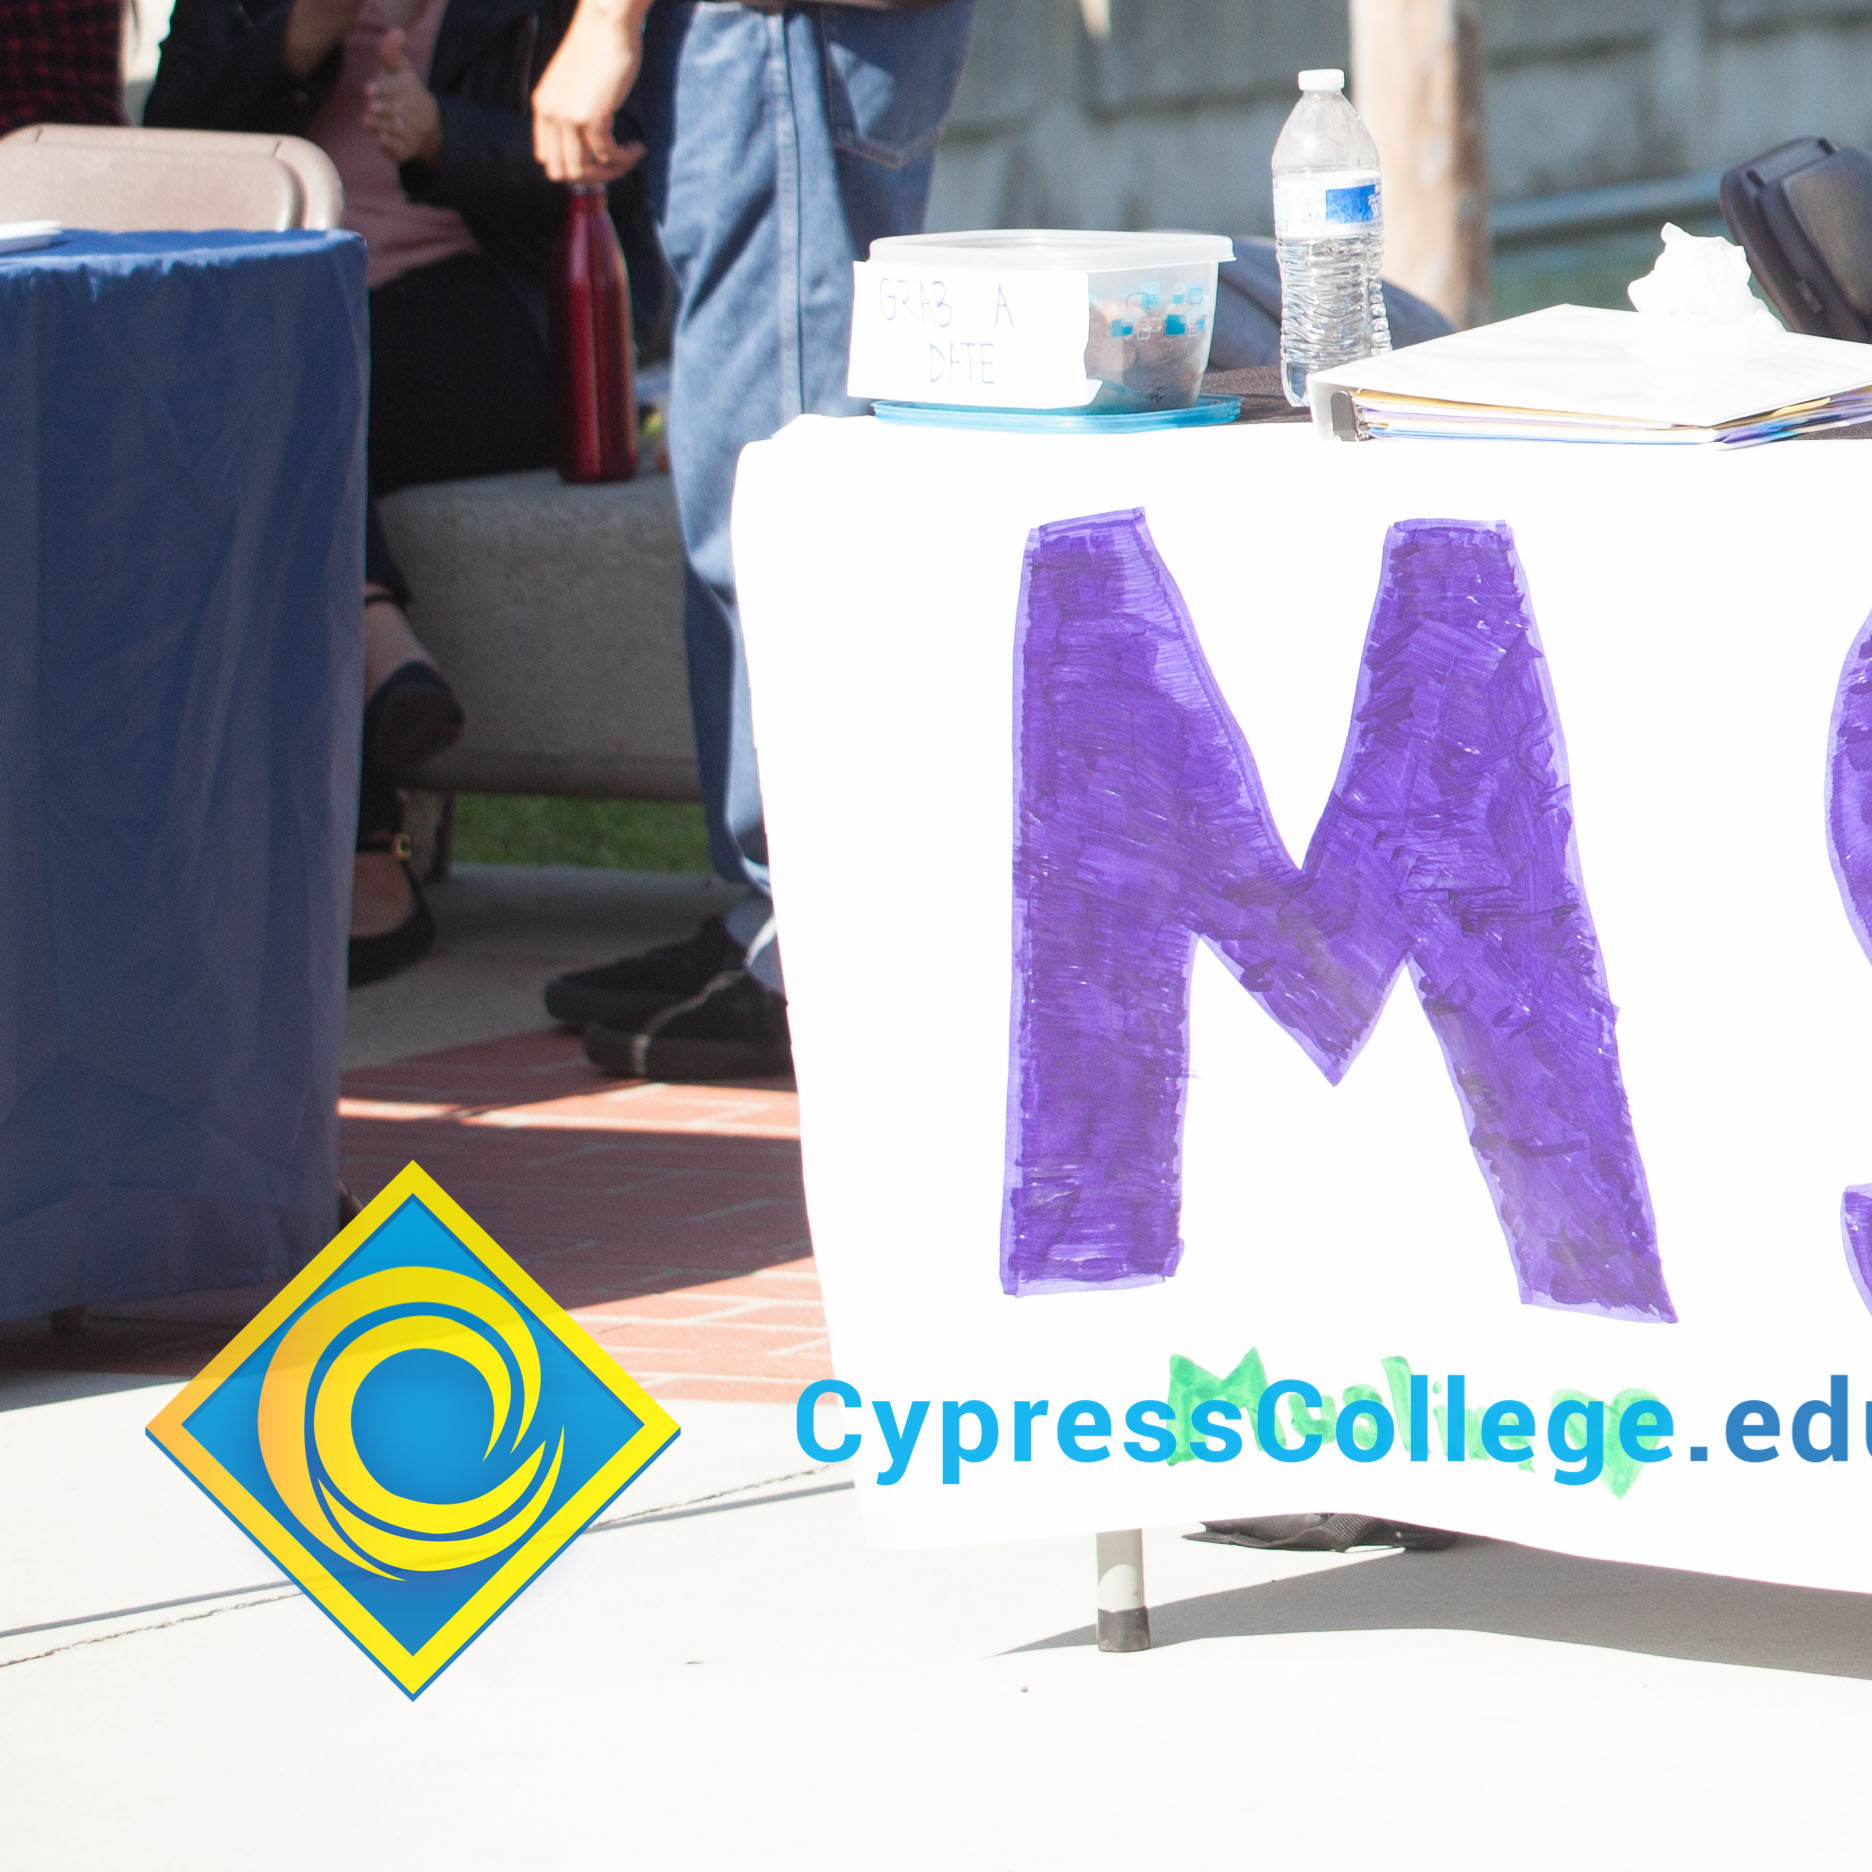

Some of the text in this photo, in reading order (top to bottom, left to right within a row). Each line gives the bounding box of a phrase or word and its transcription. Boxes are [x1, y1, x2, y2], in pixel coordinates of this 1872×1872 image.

[879, 276, 1015, 329] GRAB A
[928, 341, 996, 385] DATE
